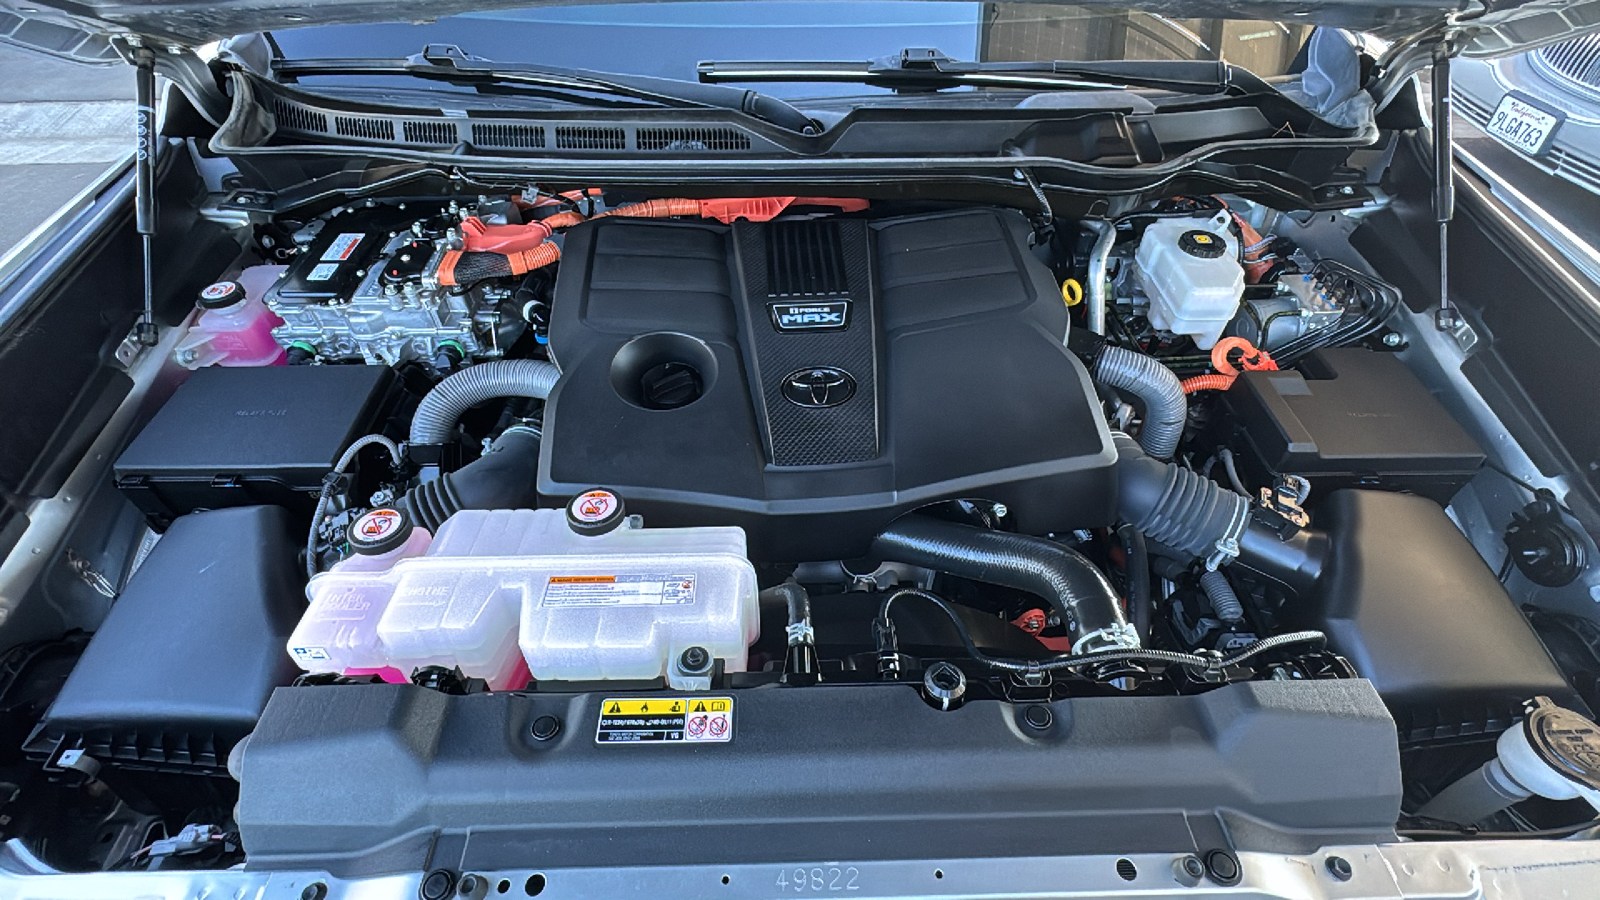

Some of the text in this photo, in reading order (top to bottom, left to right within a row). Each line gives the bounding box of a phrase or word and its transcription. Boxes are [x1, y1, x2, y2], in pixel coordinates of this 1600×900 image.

[1491, 111, 1543, 147] 9LGA763
[781, 312, 841, 324] MAX
[775, 866, 860, 892] 49822
